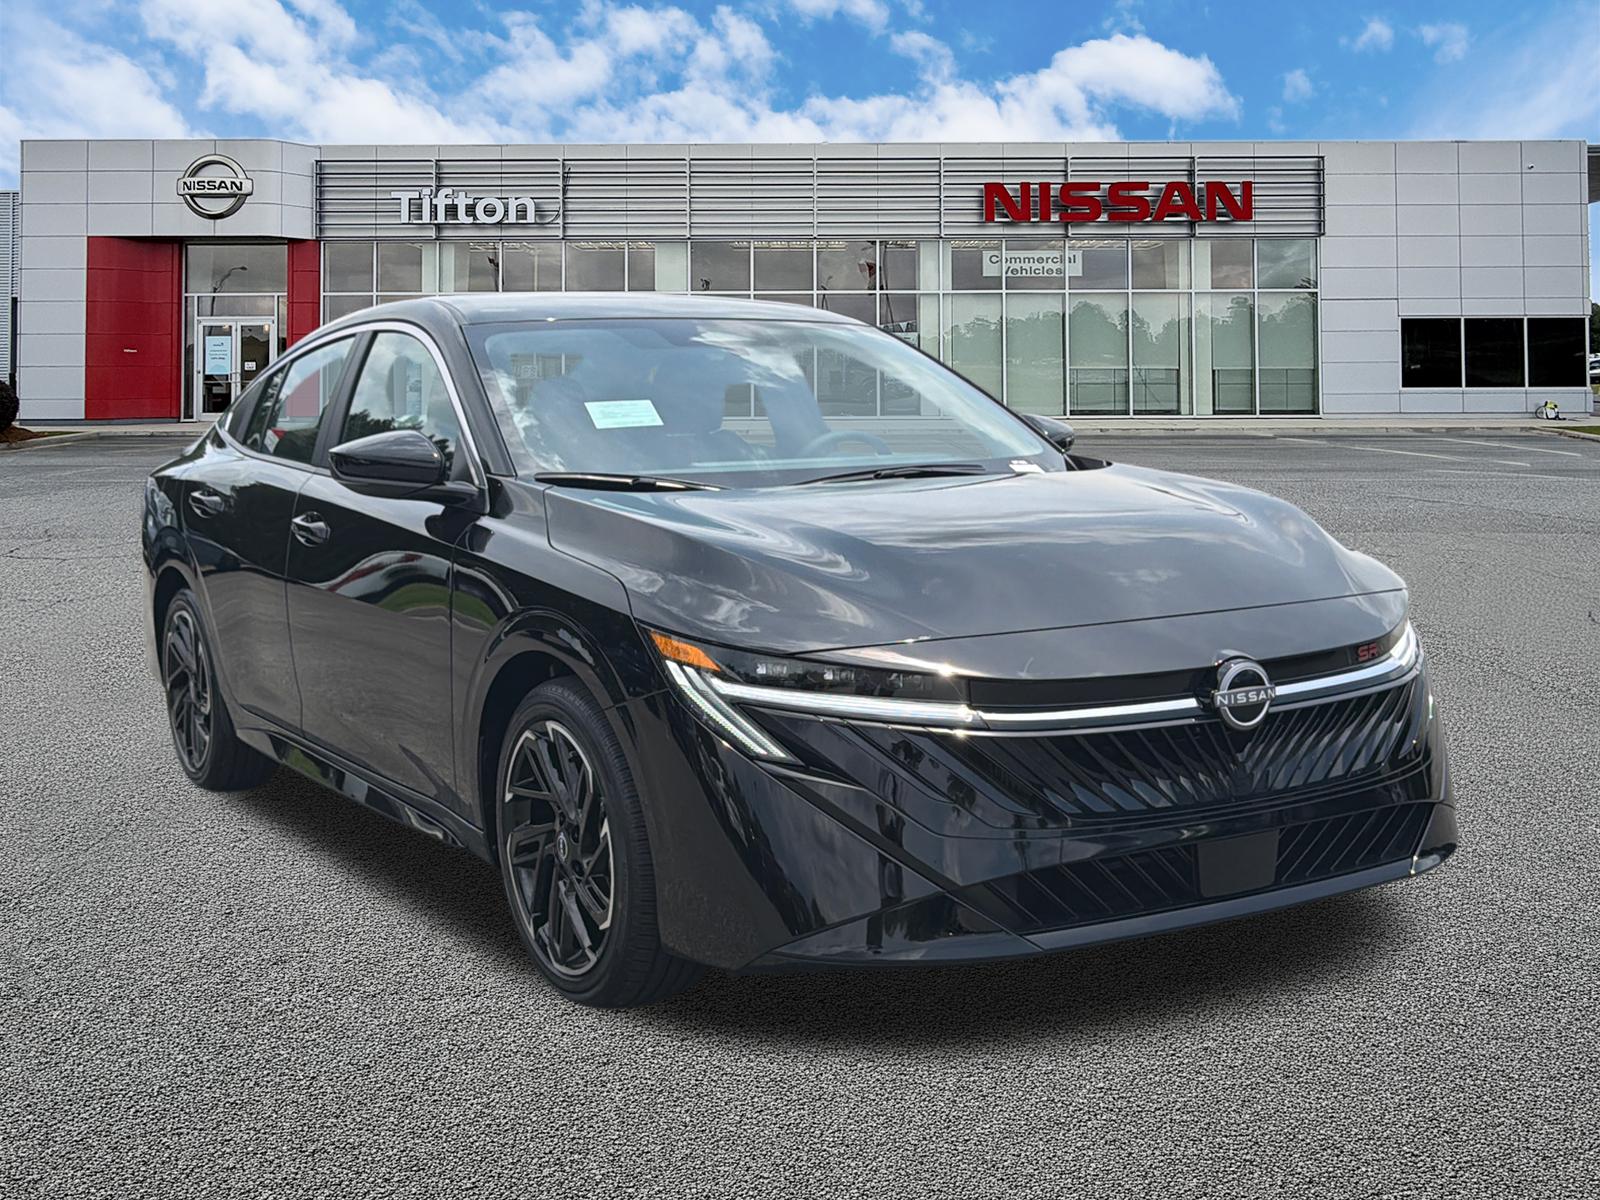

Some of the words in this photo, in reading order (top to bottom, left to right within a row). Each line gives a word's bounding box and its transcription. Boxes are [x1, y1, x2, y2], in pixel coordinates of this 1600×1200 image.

[183, 181, 243, 191] NISSAN
[391, 187, 536, 224] Tifton
[983, 181, 1253, 223] NISSAN
[1358, 642, 1377, 661] SR
[1217, 688, 1275, 706] NISSAN
